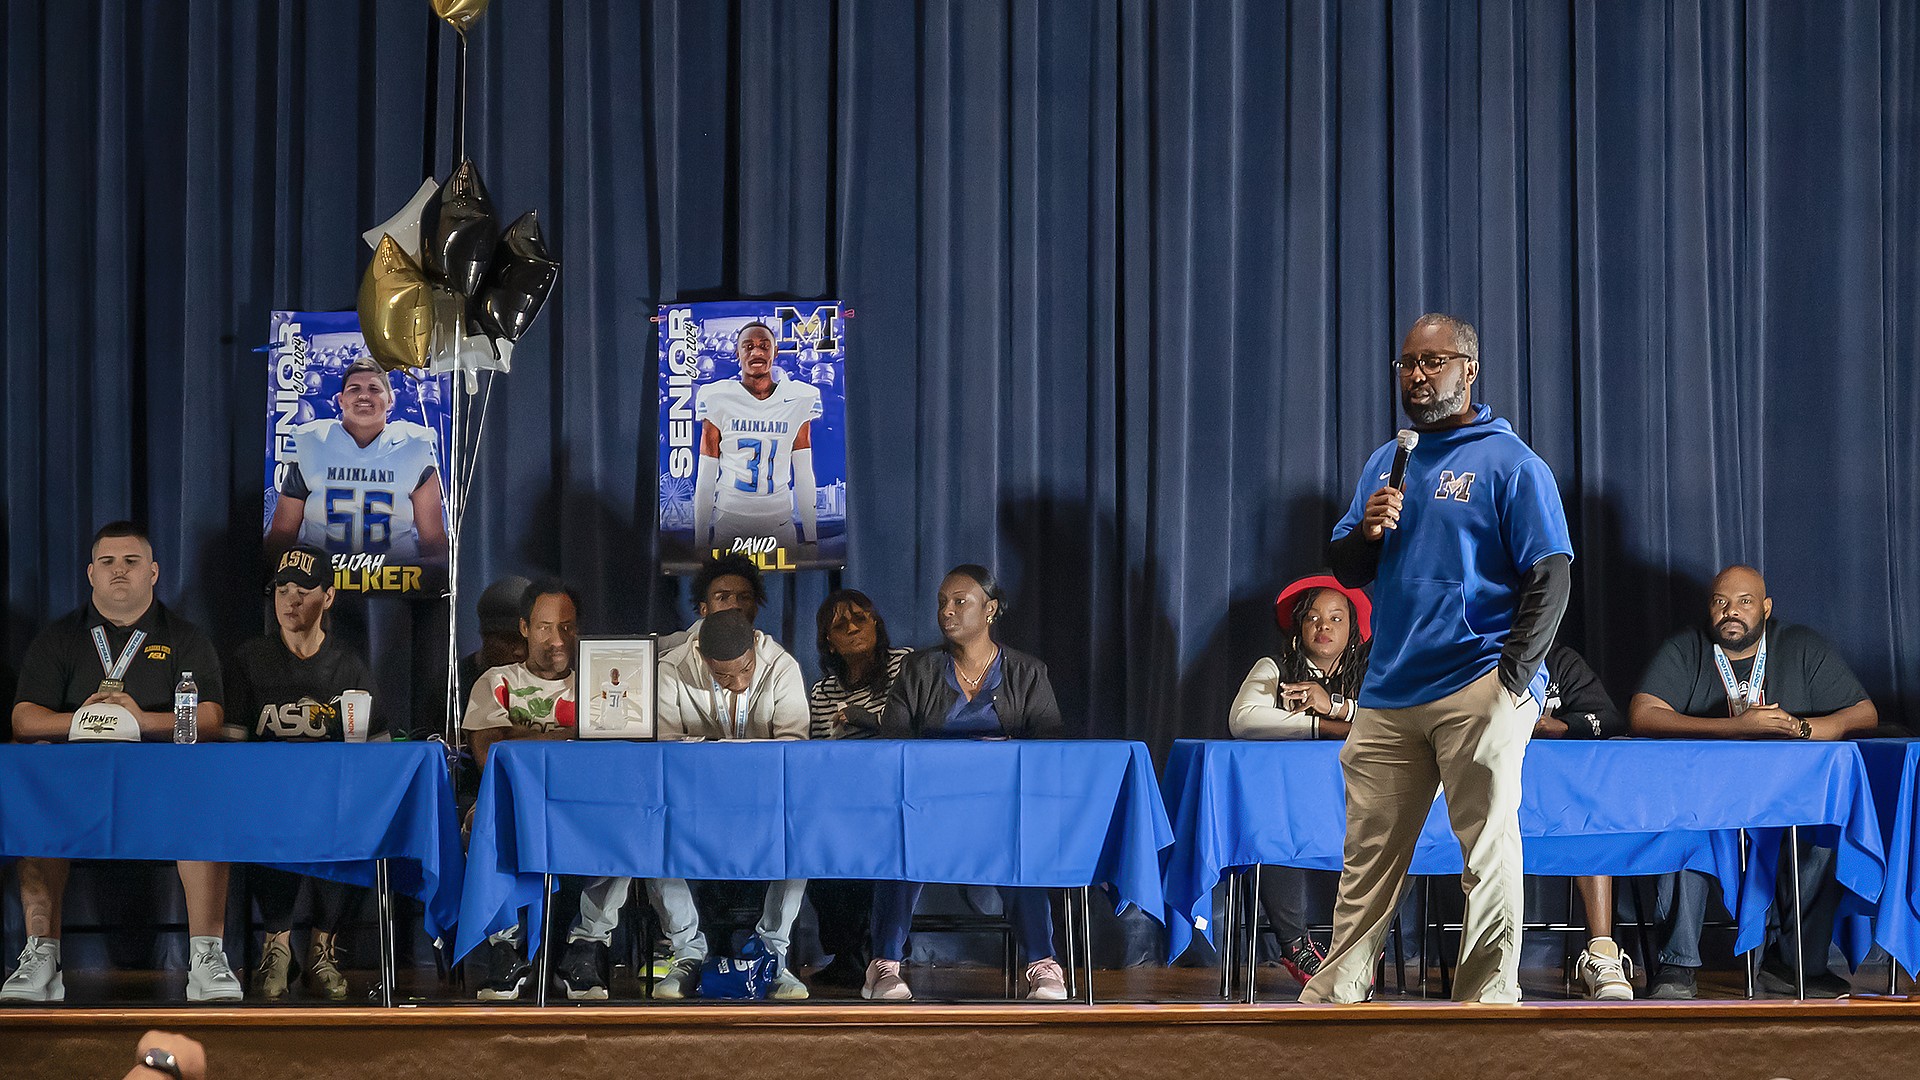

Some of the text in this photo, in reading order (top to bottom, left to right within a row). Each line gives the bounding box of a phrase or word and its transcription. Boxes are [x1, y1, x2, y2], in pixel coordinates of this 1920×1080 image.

[685, 322, 698, 351] 2024
[775, 306, 839, 353] M
[293, 337, 307, 366] 2024
[668, 309, 692, 478] SENIOR
[731, 419, 788, 433] MAINLAND
[327, 467, 394, 482] MAINLAND
[735, 438, 778, 494] 31
[1435, 470, 1476, 503] M
[325, 487, 394, 552] 56
[712, 547, 796, 570] LL
[731, 536, 777, 556] DAVID
[278, 551, 315, 576] ASU
[331, 553, 386, 573] ELIJAH
[334, 565, 422, 593] LKER
[95, 631, 110, 663] FOOTBALL
[147, 652, 166, 660] ASU
[1717, 654, 1734, 688] FOOTBALL
[1753, 652, 1766, 688] FOOTBALL
[256, 702, 327, 738] ASU
